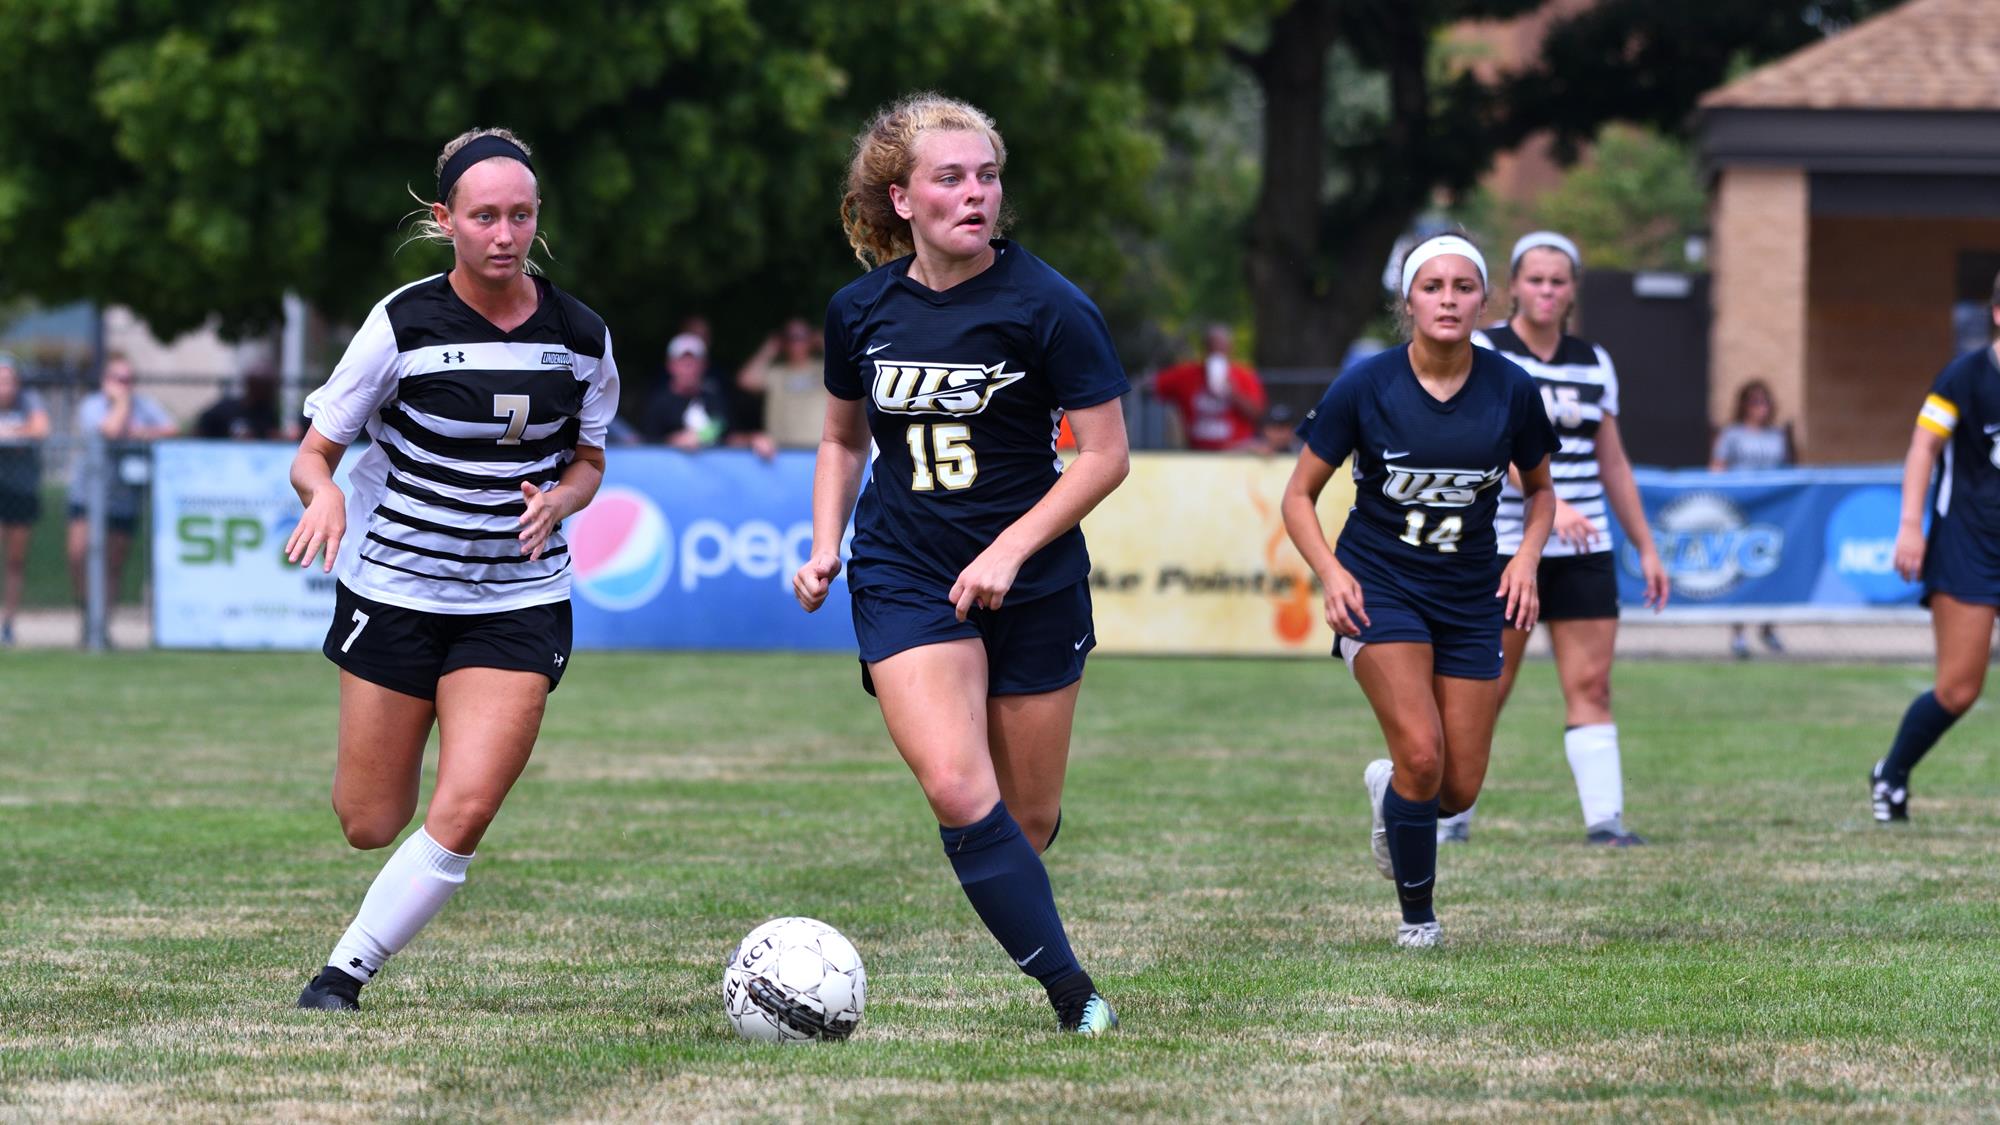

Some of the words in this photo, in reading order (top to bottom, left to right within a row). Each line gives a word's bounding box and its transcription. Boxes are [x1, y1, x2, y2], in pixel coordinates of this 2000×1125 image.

[873, 361, 988, 416] UIS
[493, 394, 530, 445] 7
[906, 423, 978, 490] 15
[1383, 465, 1490, 507] UIS
[680, 519, 846, 592] pep
[1399, 509, 1462, 552] 14
[341, 609, 370, 654] 7
